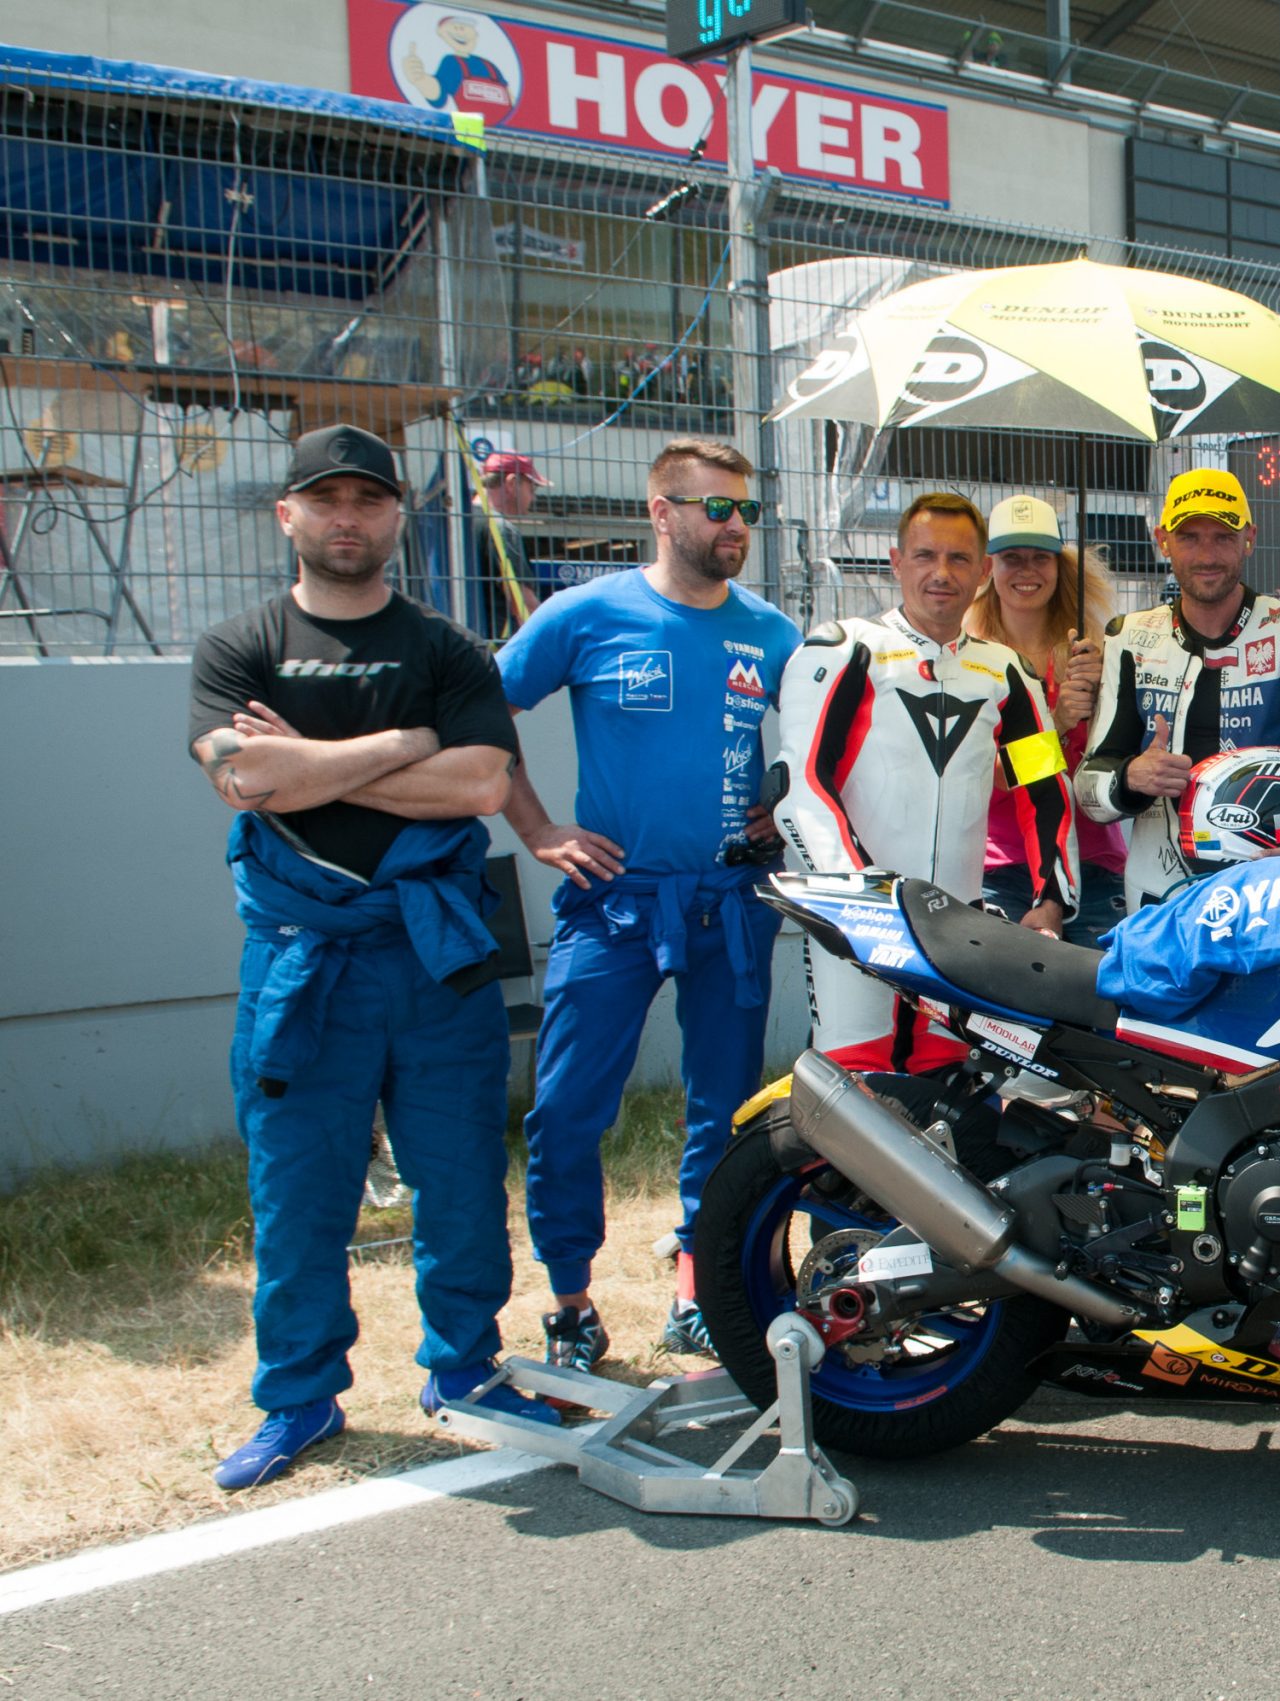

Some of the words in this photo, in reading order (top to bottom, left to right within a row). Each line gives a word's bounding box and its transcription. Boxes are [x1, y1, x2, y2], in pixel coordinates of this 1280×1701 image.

[1161, 309, 1247, 319] DUNLOP
[1162, 319, 1251, 328] MOTORSPORT
[1172, 487, 1238, 508] DUNLOP
[733, 642, 765, 658] YAMAHA
[275, 659, 402, 678] thor
[1144, 672, 1169, 687] Beta
[1209, 807, 1251, 825] Arai
[855, 923, 905, 942] YAMAHA
[868, 945, 916, 969] YART
[985, 1020, 1037, 1052] MODULAR
[982, 1040, 1060, 1079] DUNLOP
